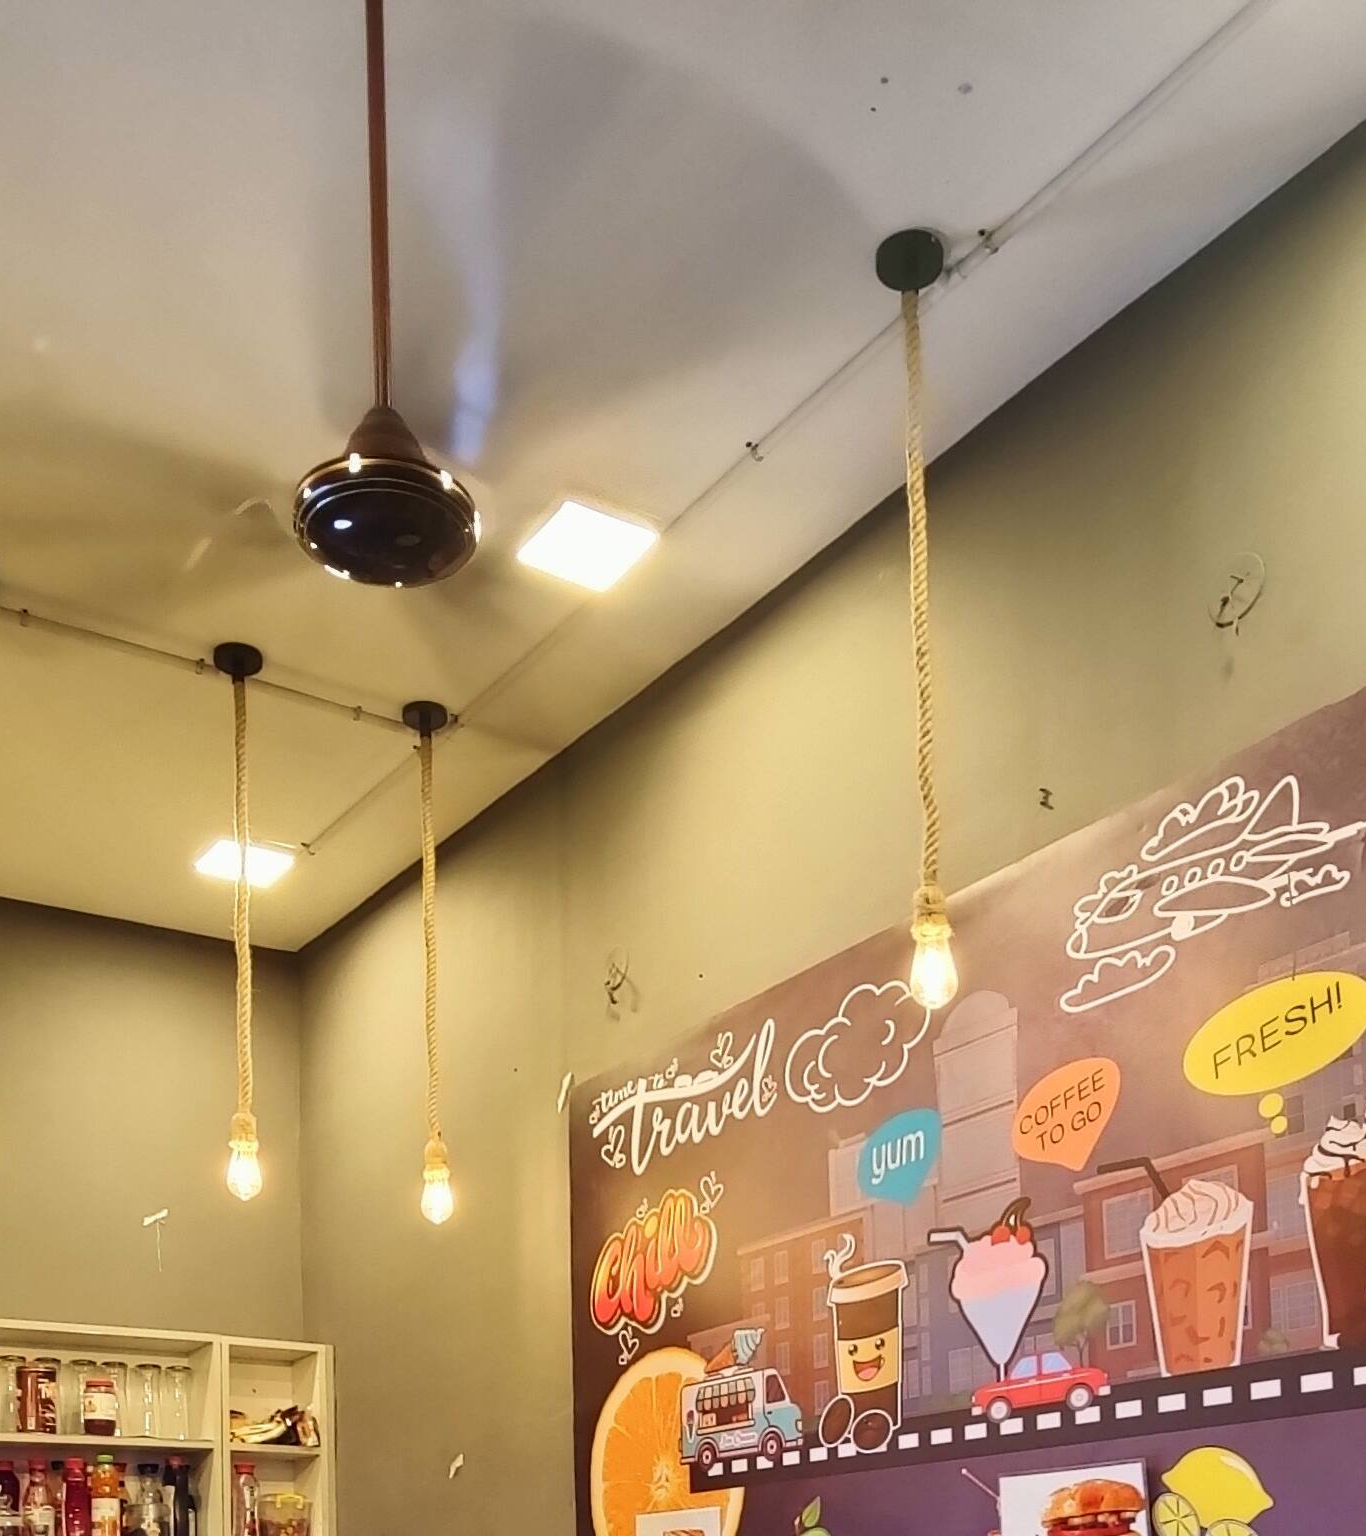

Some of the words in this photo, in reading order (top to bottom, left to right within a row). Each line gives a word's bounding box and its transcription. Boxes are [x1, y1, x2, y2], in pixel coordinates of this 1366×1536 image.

[1212, 981, 1343, 1080] FRESH!
[1019, 1068, 1107, 1136] COFFEE
[1036, 1124, 1065, 1154] TO
[1071, 1101, 1103, 1133] GO
[871, 1128, 925, 1186] yum
